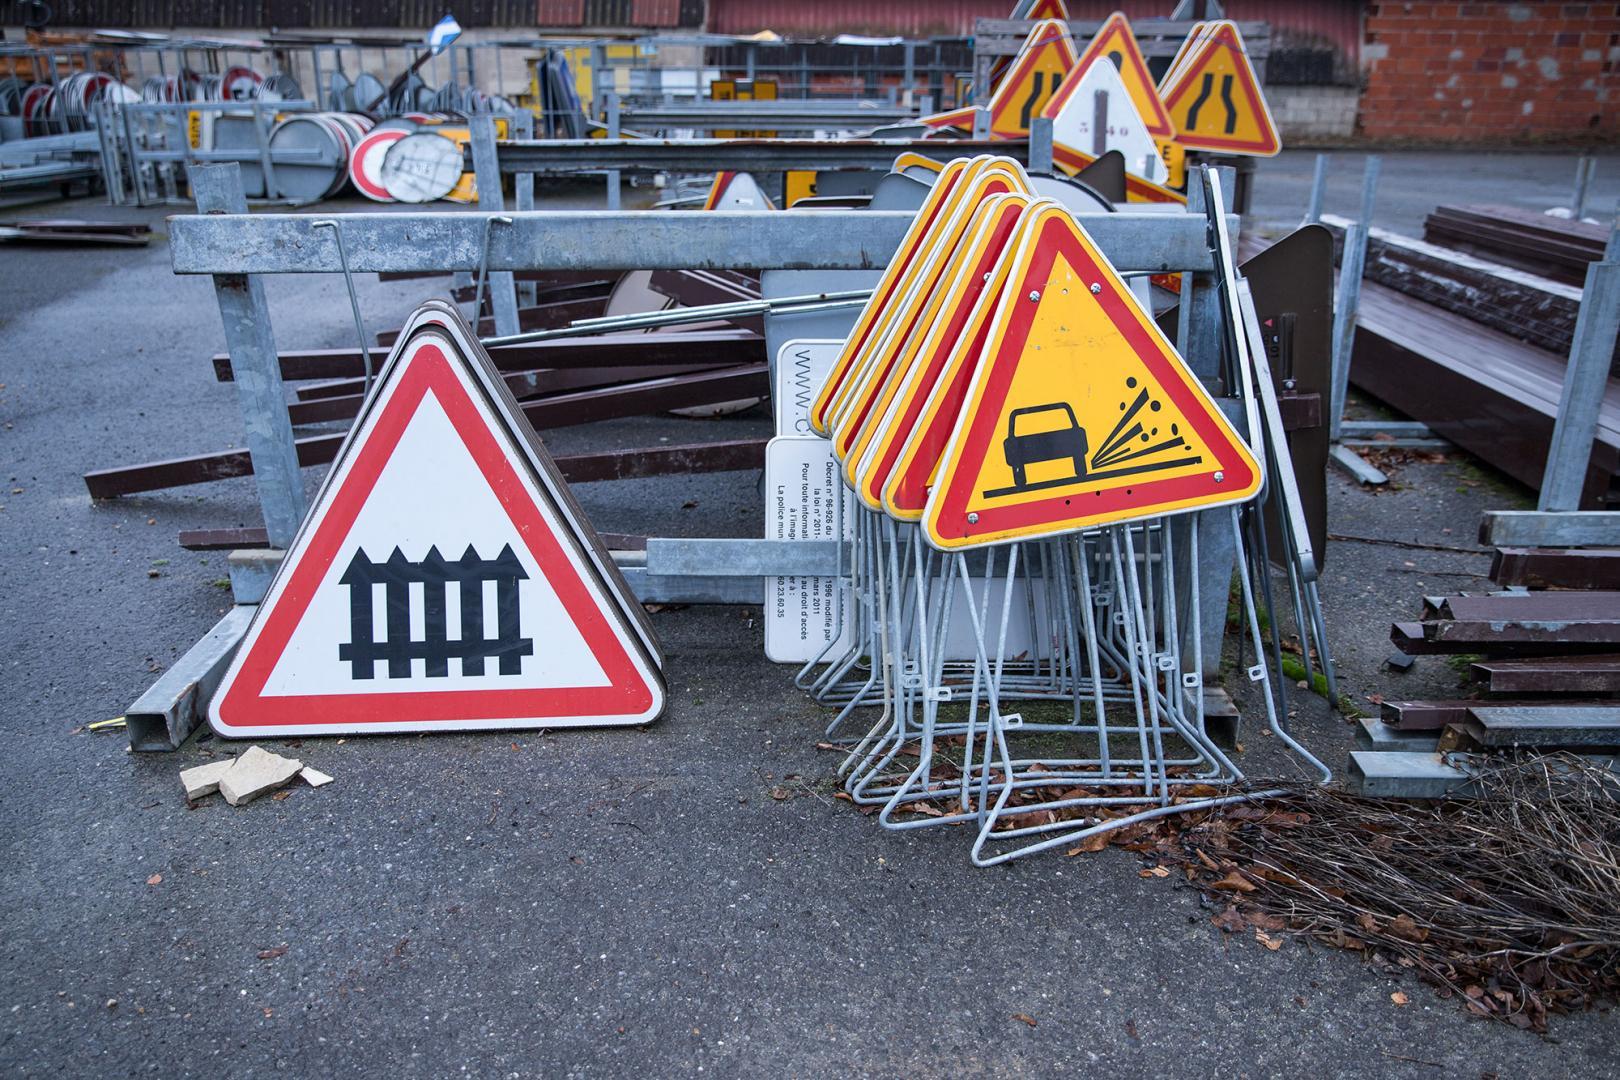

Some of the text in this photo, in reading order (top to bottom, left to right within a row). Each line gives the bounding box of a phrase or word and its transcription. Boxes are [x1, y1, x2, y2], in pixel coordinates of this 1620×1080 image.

[795, 350, 811, 436] www.c
[801, 463, 809, 481] Pour
[825, 461, 833, 487] Décret
[778, 485, 785, 495] La
[814, 488, 821, 496] la
[776, 496, 785, 520] police
[825, 498, 833, 524] 96-926
[801, 504, 809, 539] informati
[813, 519, 821, 539] 2011-
[825, 525, 833, 536] du
[801, 580, 807, 590] au
